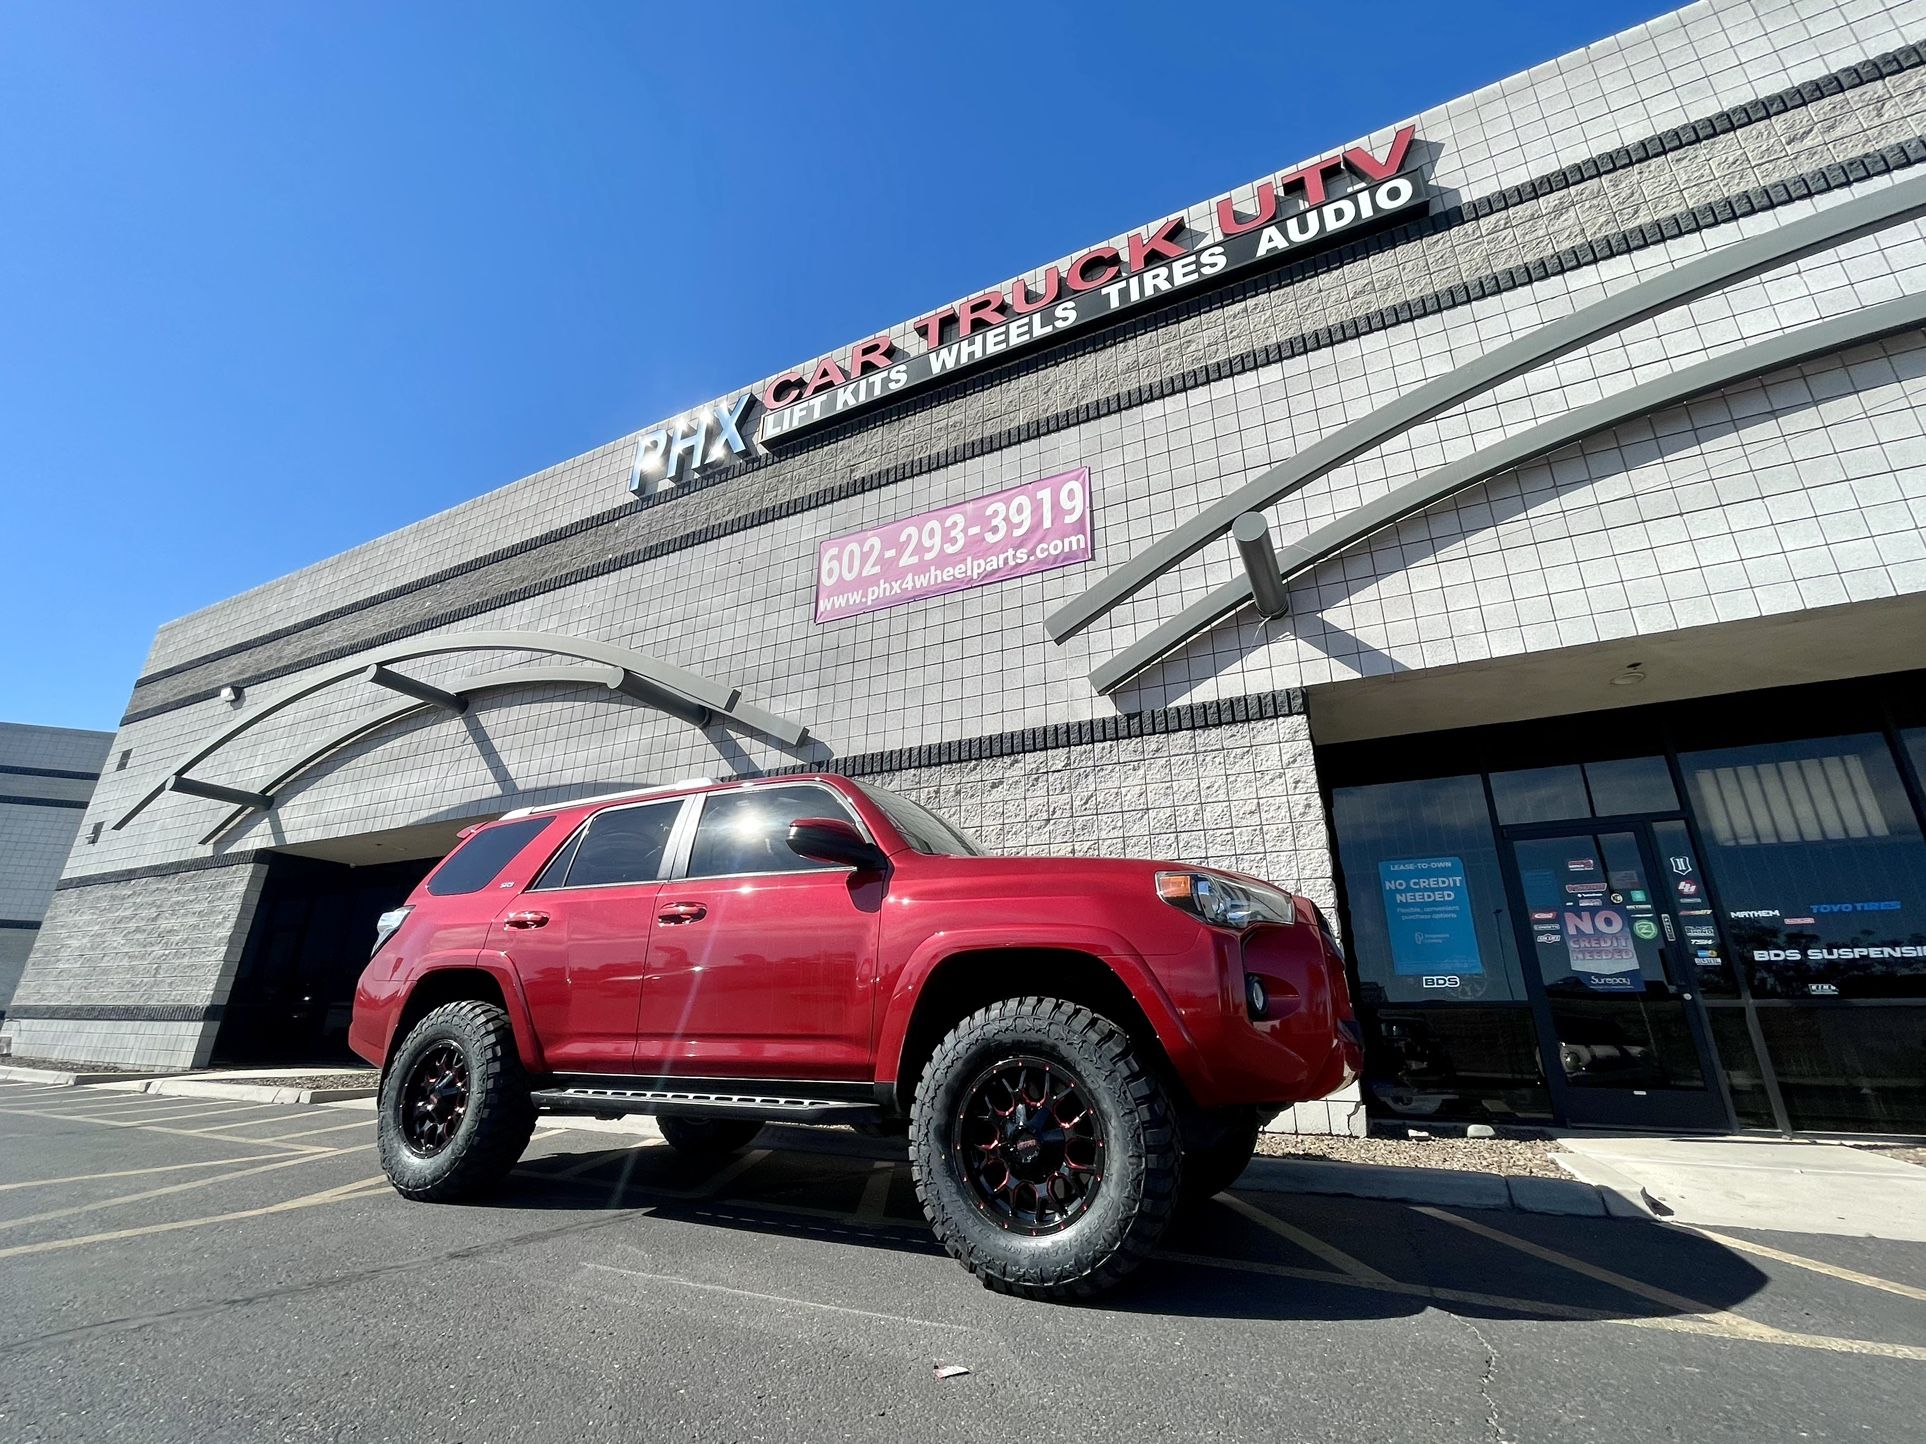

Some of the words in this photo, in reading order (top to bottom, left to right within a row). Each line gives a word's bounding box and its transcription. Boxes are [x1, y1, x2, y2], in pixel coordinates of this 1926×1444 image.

[630, 391, 754, 492] PHX
[763, 336, 893, 411] CAR
[914, 217, 1189, 350] TRUCK
[1216, 123, 1416, 236] UTV
[765, 392, 829, 437] LIFT
[835, 363, 908, 411] KITS
[928, 301, 1079, 375] WHEELS
[1101, 245, 1228, 310] TIRES
[1255, 177, 1414, 258] AUDIO
[820, 479, 1085, 588] 602-293-3919
[818, 532, 1086, 613] www.phx4wheelparts.com
[1390, 861, 1452, 871] LEASE-TO-OWN
[1385, 879, 1407, 890] NO
[1410, 876, 1462, 888] CREDIT
[1396, 891, 1455, 903] NEEDED
[1854, 901, 1901, 911] TIRES
[1730, 909, 1781, 919] MAYHEM
[1564, 910, 1623, 935] NO
[1569, 937, 1629, 948] CREDIT
[1573, 948, 1634, 960] NEEDED
[1753, 949, 1801, 961] BDS
[1807, 945, 1926, 960] SUSPENSI
[1422, 976, 1460, 988] BDS
